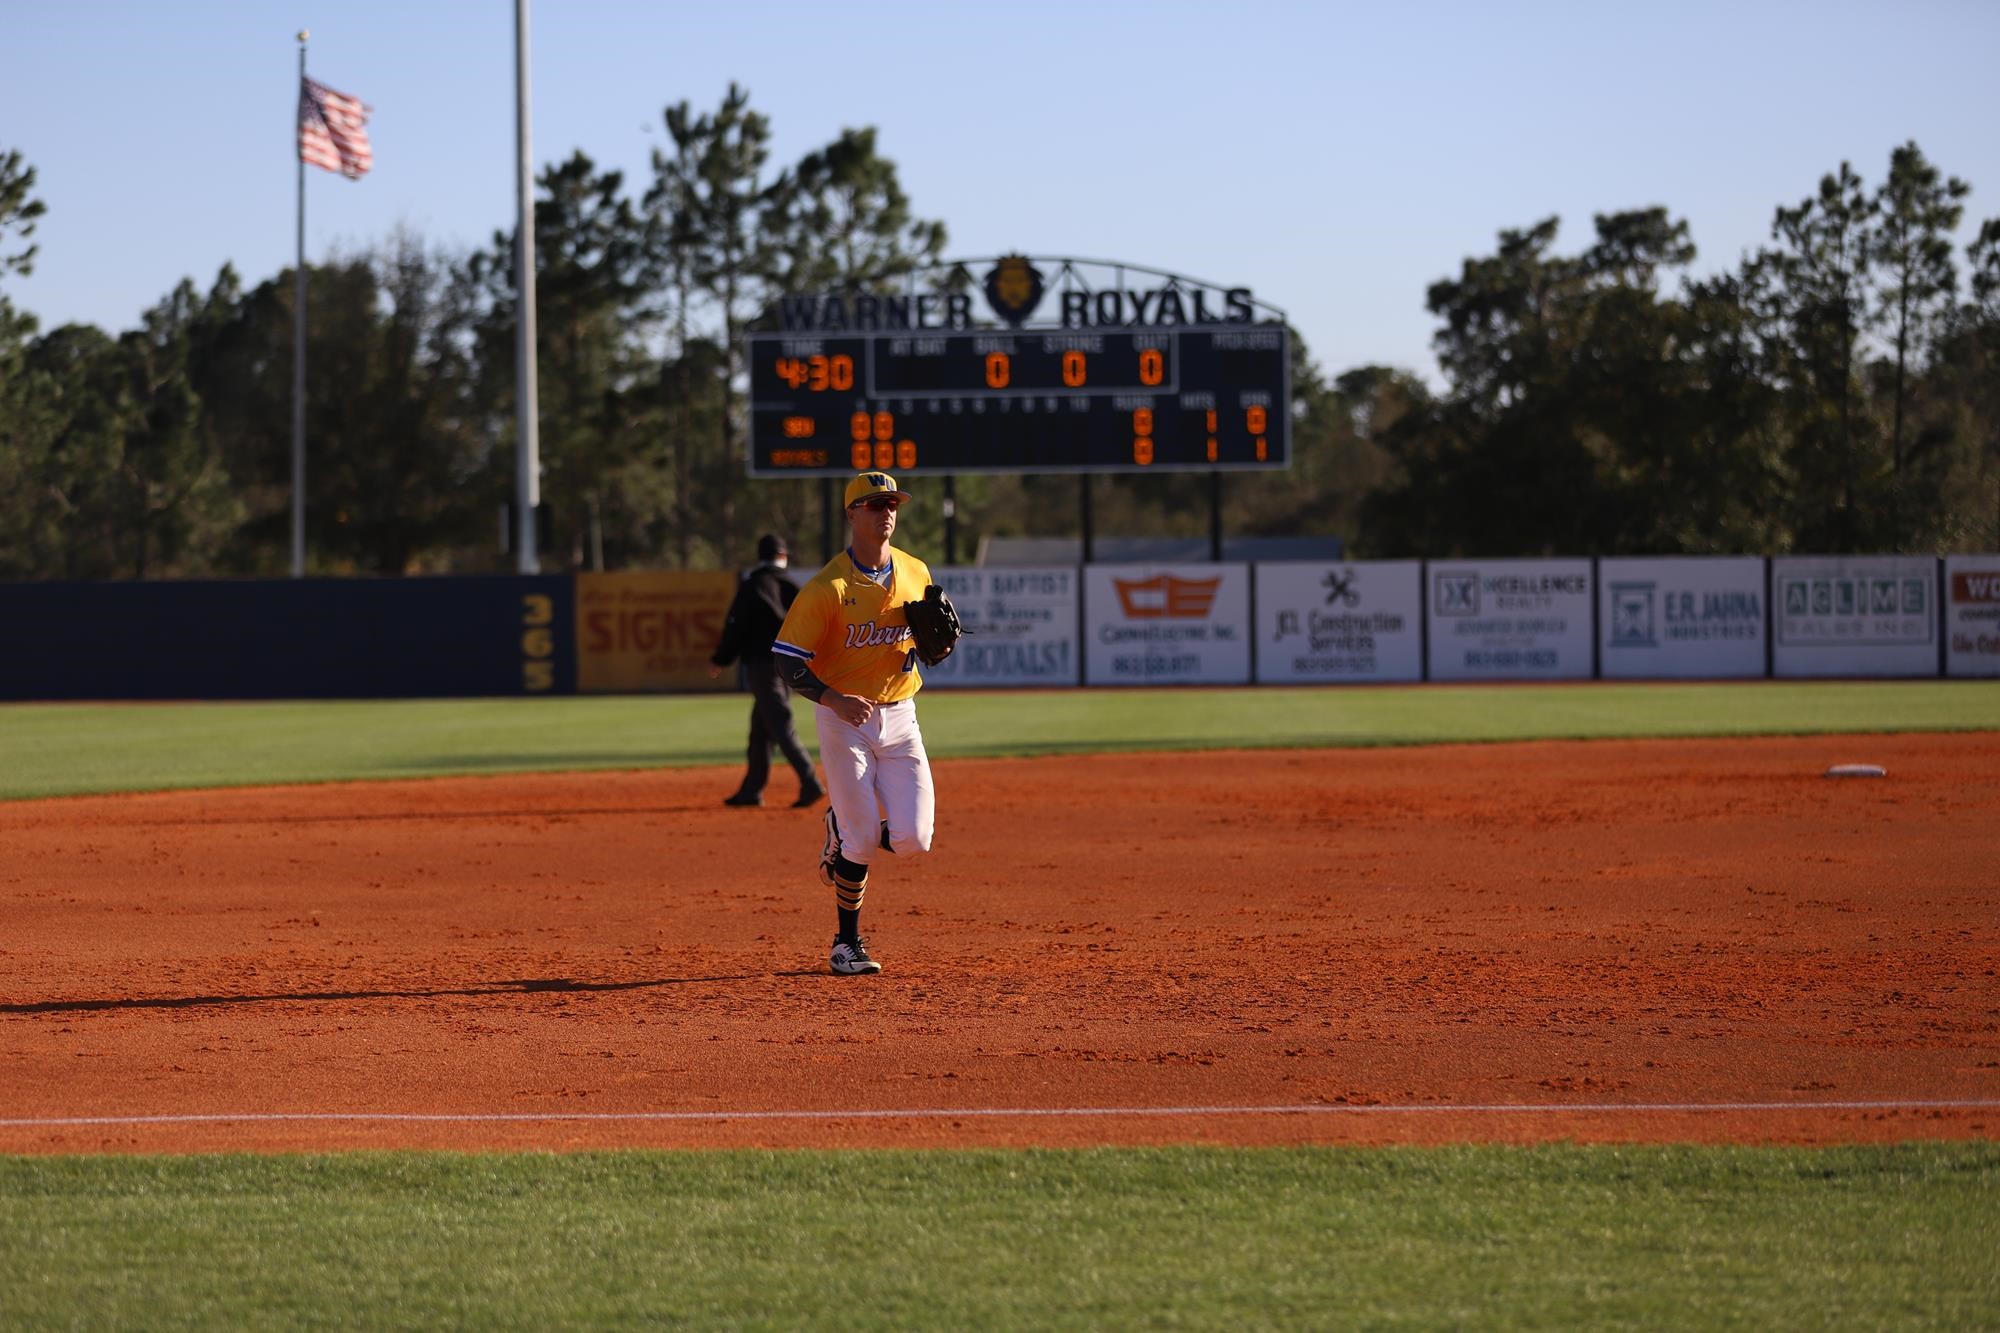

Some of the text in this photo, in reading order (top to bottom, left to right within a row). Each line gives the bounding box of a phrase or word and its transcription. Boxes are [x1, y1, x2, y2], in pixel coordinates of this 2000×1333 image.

[782, 288, 1253, 330] WARNER ROYALS
[776, 354, 854, 391] 4:30
[985, 351, 1010, 389] 0
[1063, 350, 1087, 387] 0
[1139, 348, 1163, 386] 0
[587, 608, 723, 654] SIGNS
[844, 620, 913, 649] Warne
[1309, 609, 1404, 633] Construction
